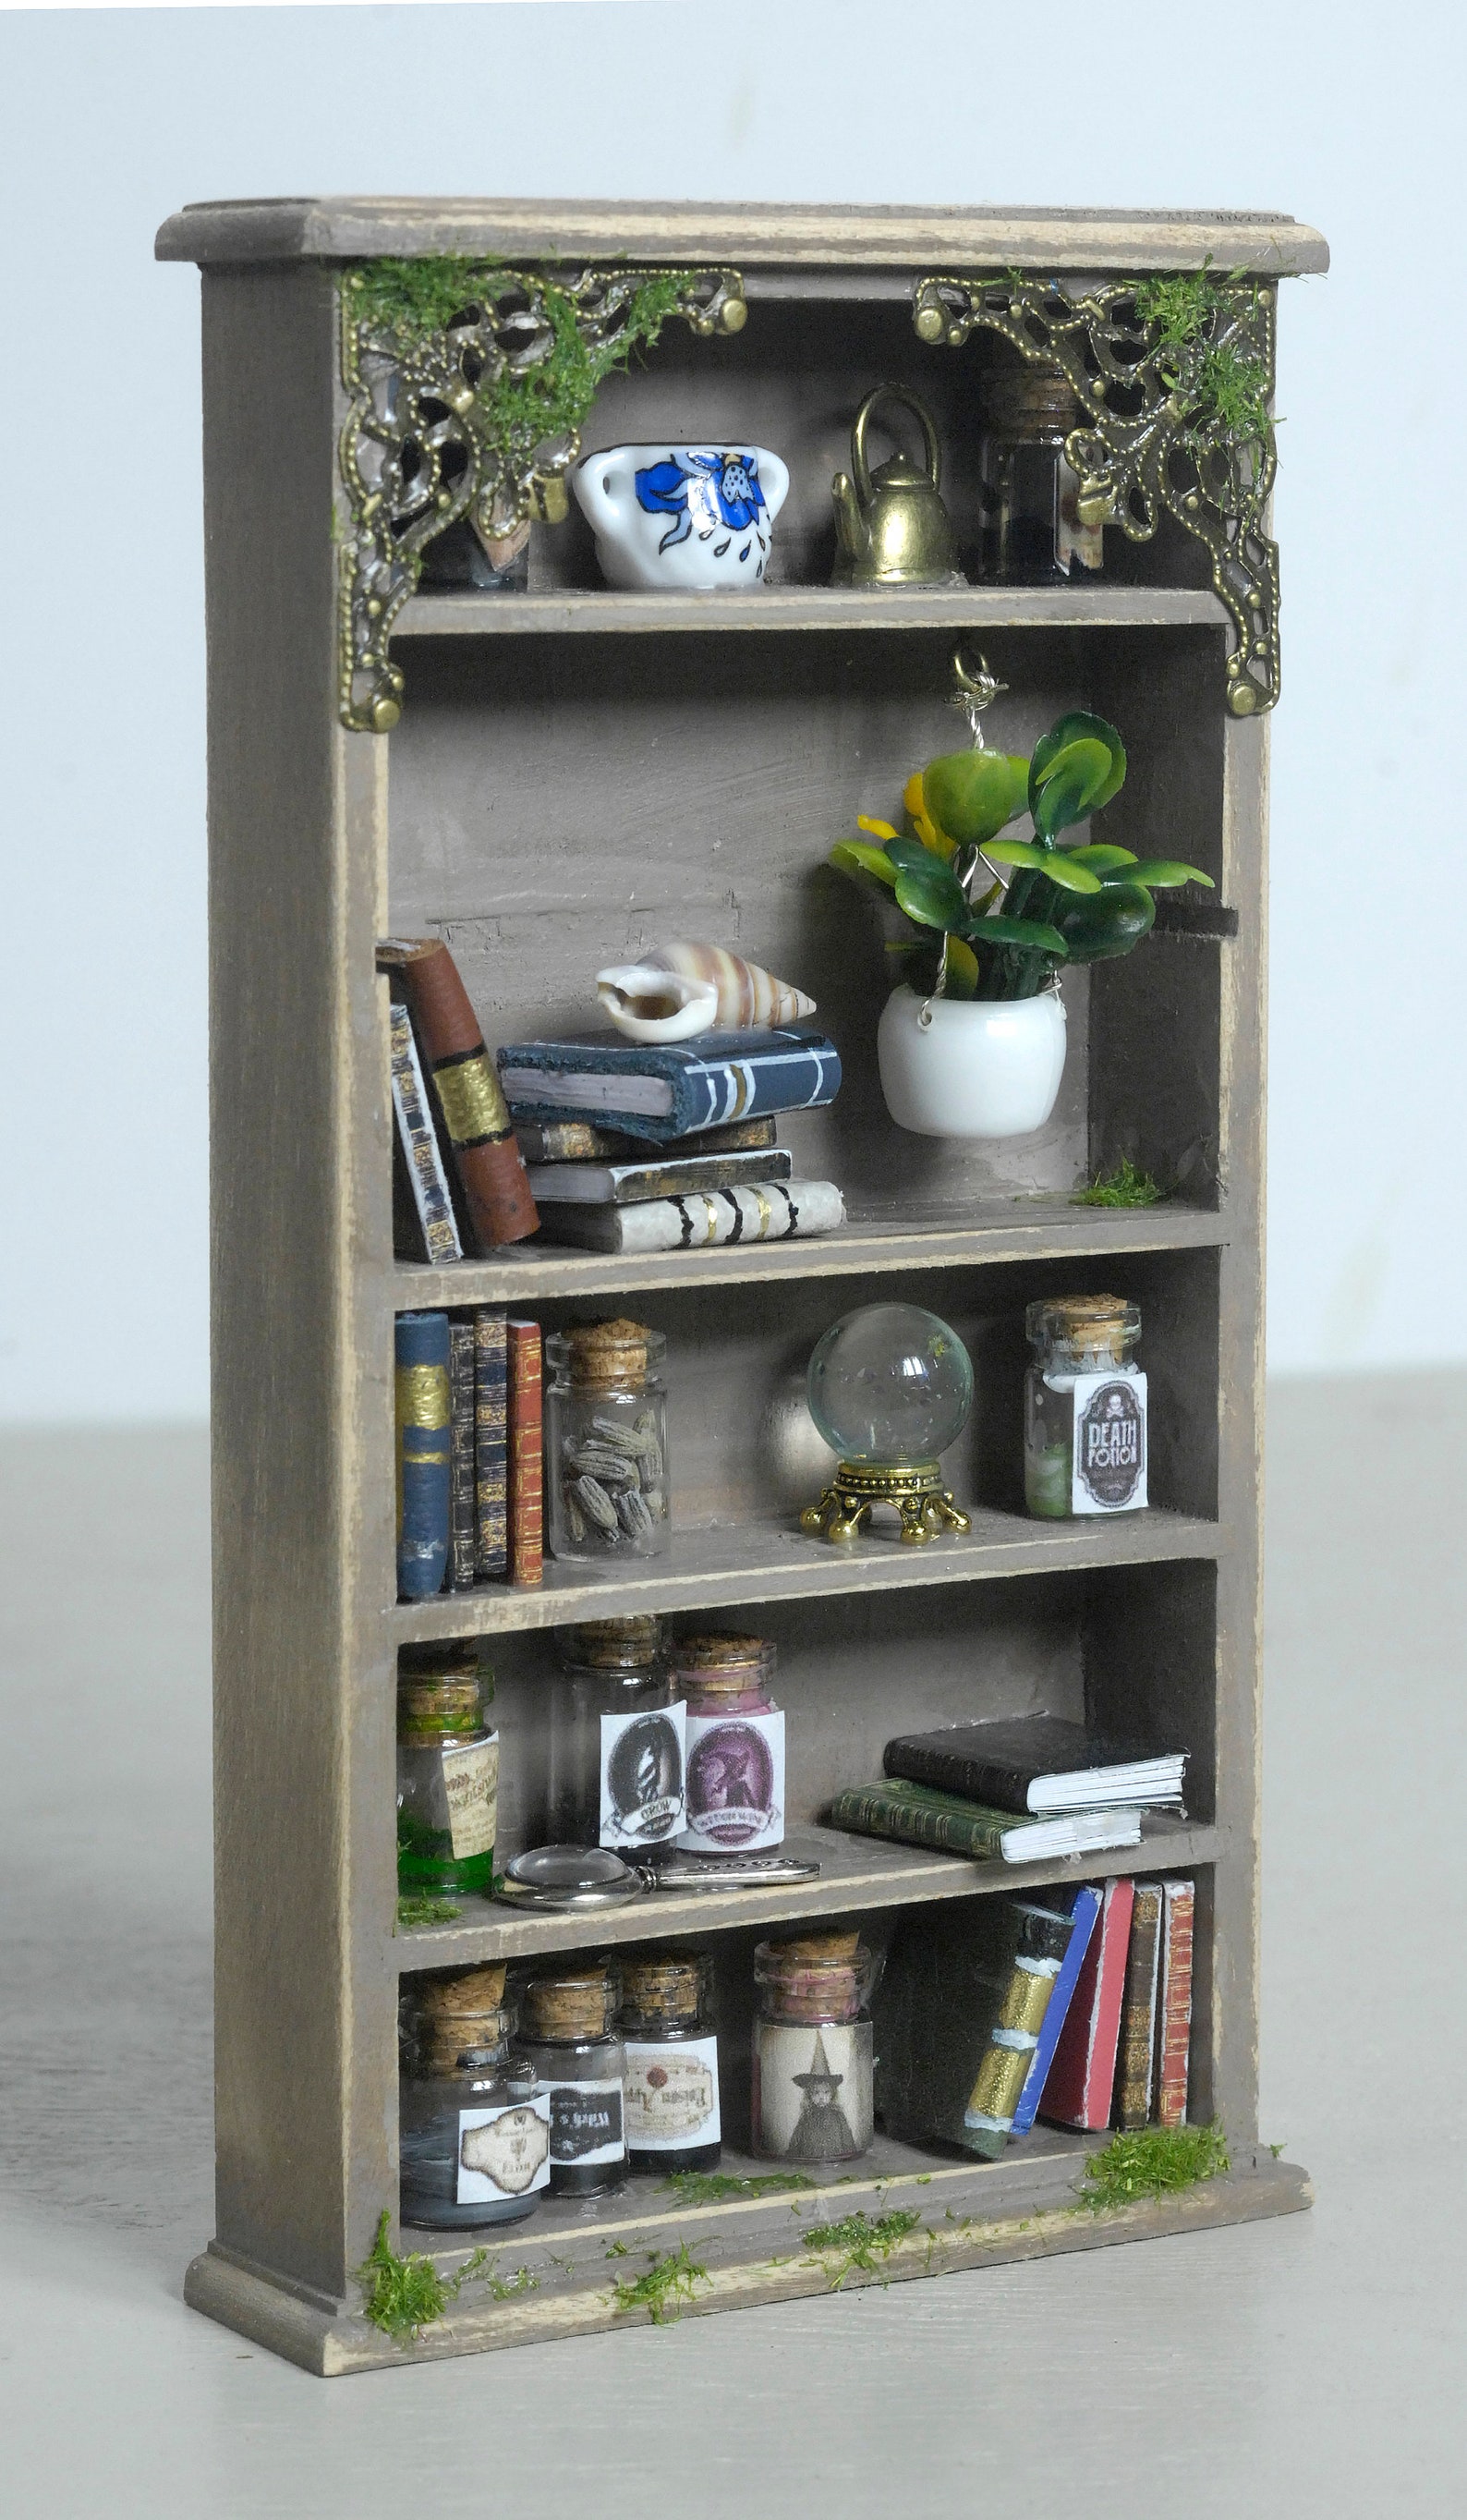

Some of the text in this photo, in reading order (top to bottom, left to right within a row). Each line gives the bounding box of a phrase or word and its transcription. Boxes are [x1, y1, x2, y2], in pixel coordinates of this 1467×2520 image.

[1088, 1419, 1136, 1448] DEATH
[1088, 1446, 1136, 1467] POTION
[640, 1799, 672, 1820] CROW
